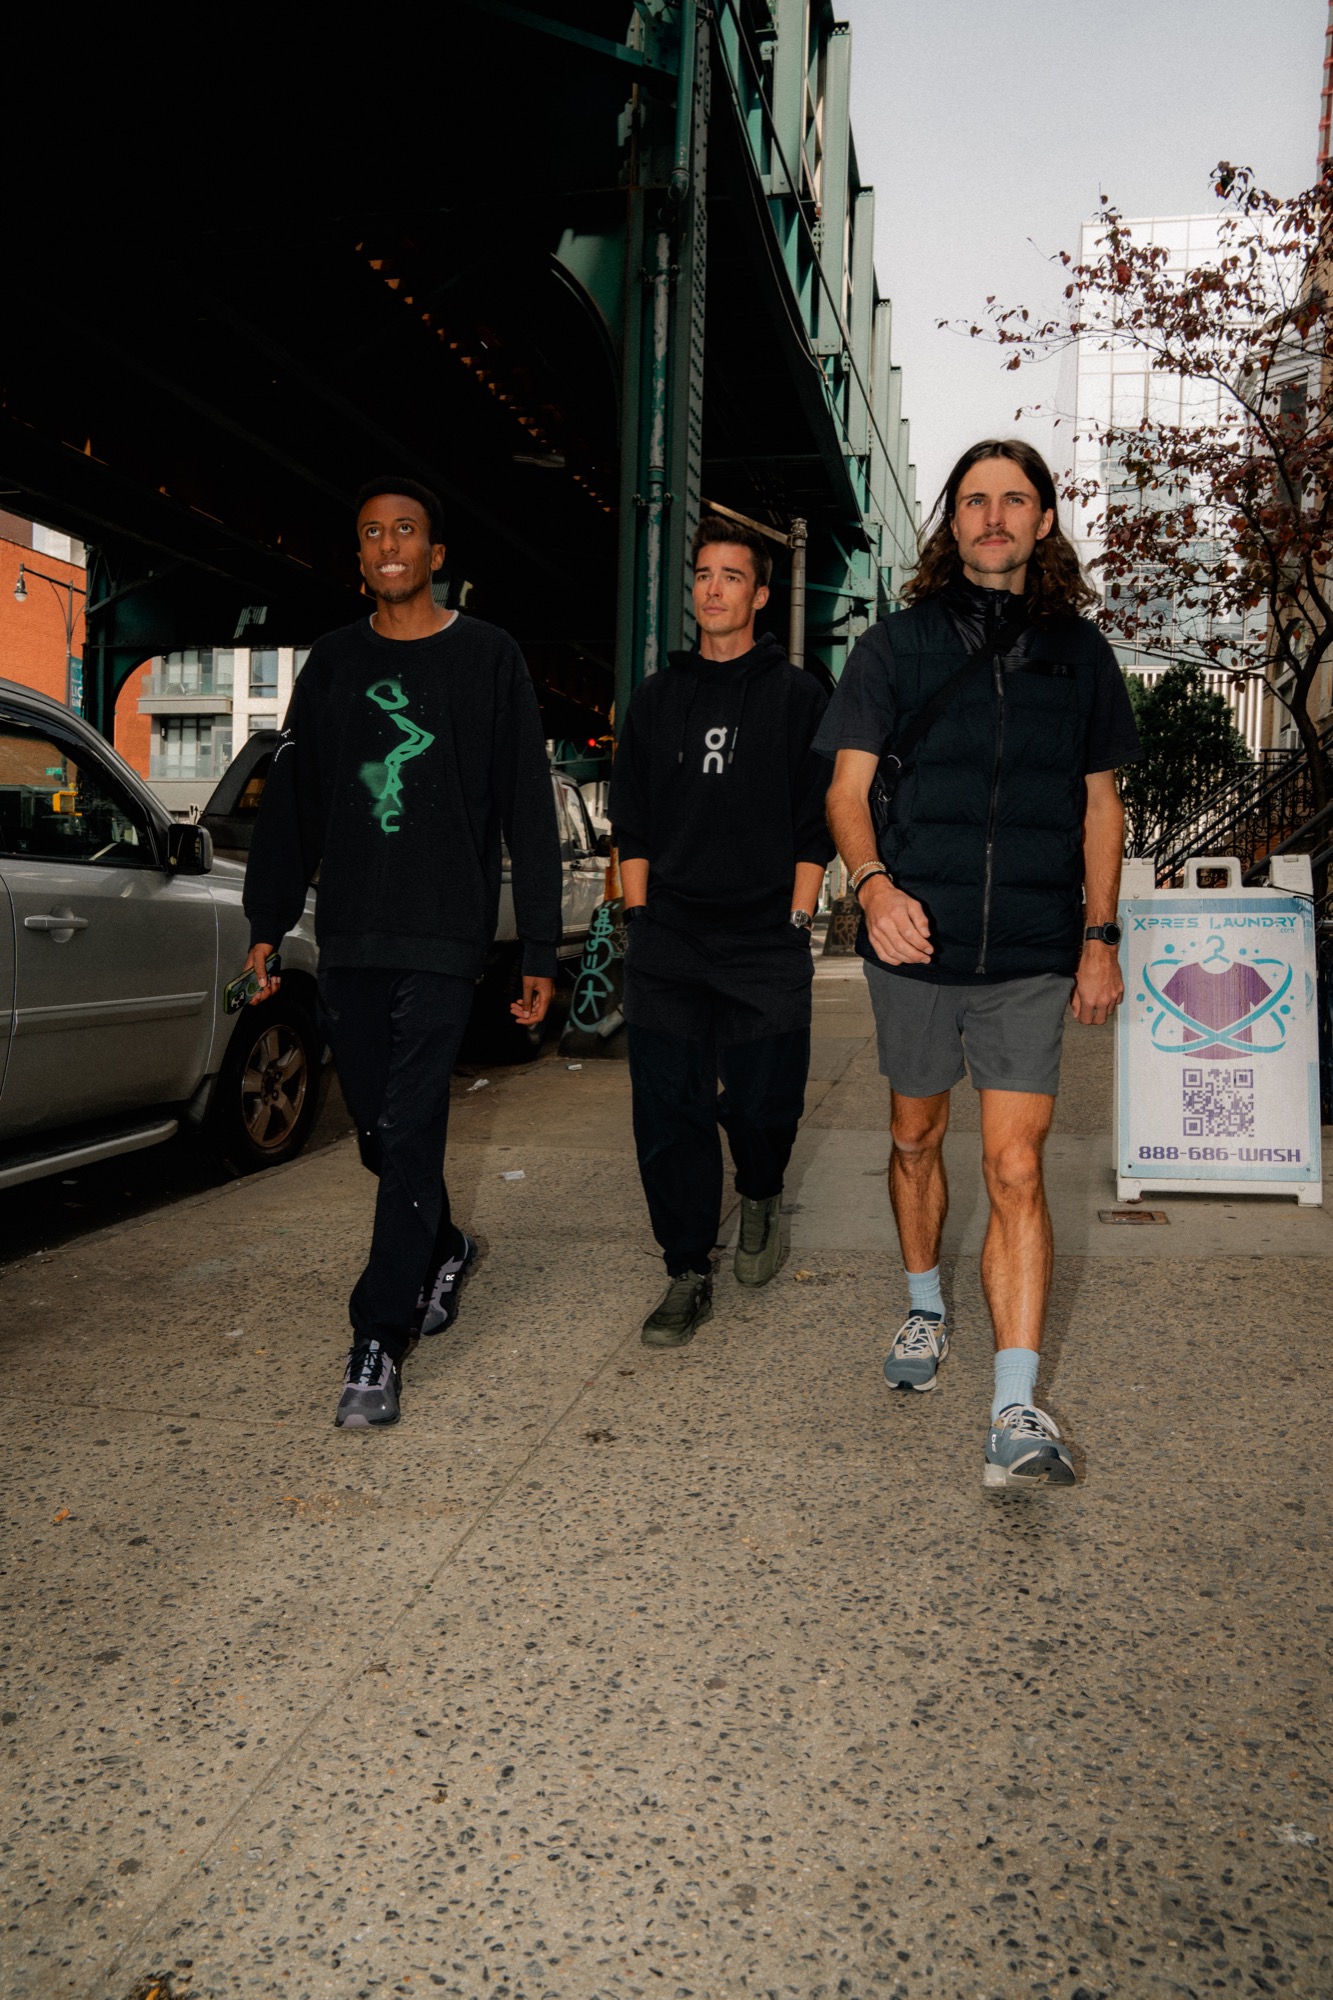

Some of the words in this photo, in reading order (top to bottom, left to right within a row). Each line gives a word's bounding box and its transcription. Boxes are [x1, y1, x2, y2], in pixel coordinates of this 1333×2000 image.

[1133, 917, 1199, 931] XPRES
[1210, 916, 1297, 930] LAUNDRY
[1138, 1146, 1301, 1162] 888-686-WASH
